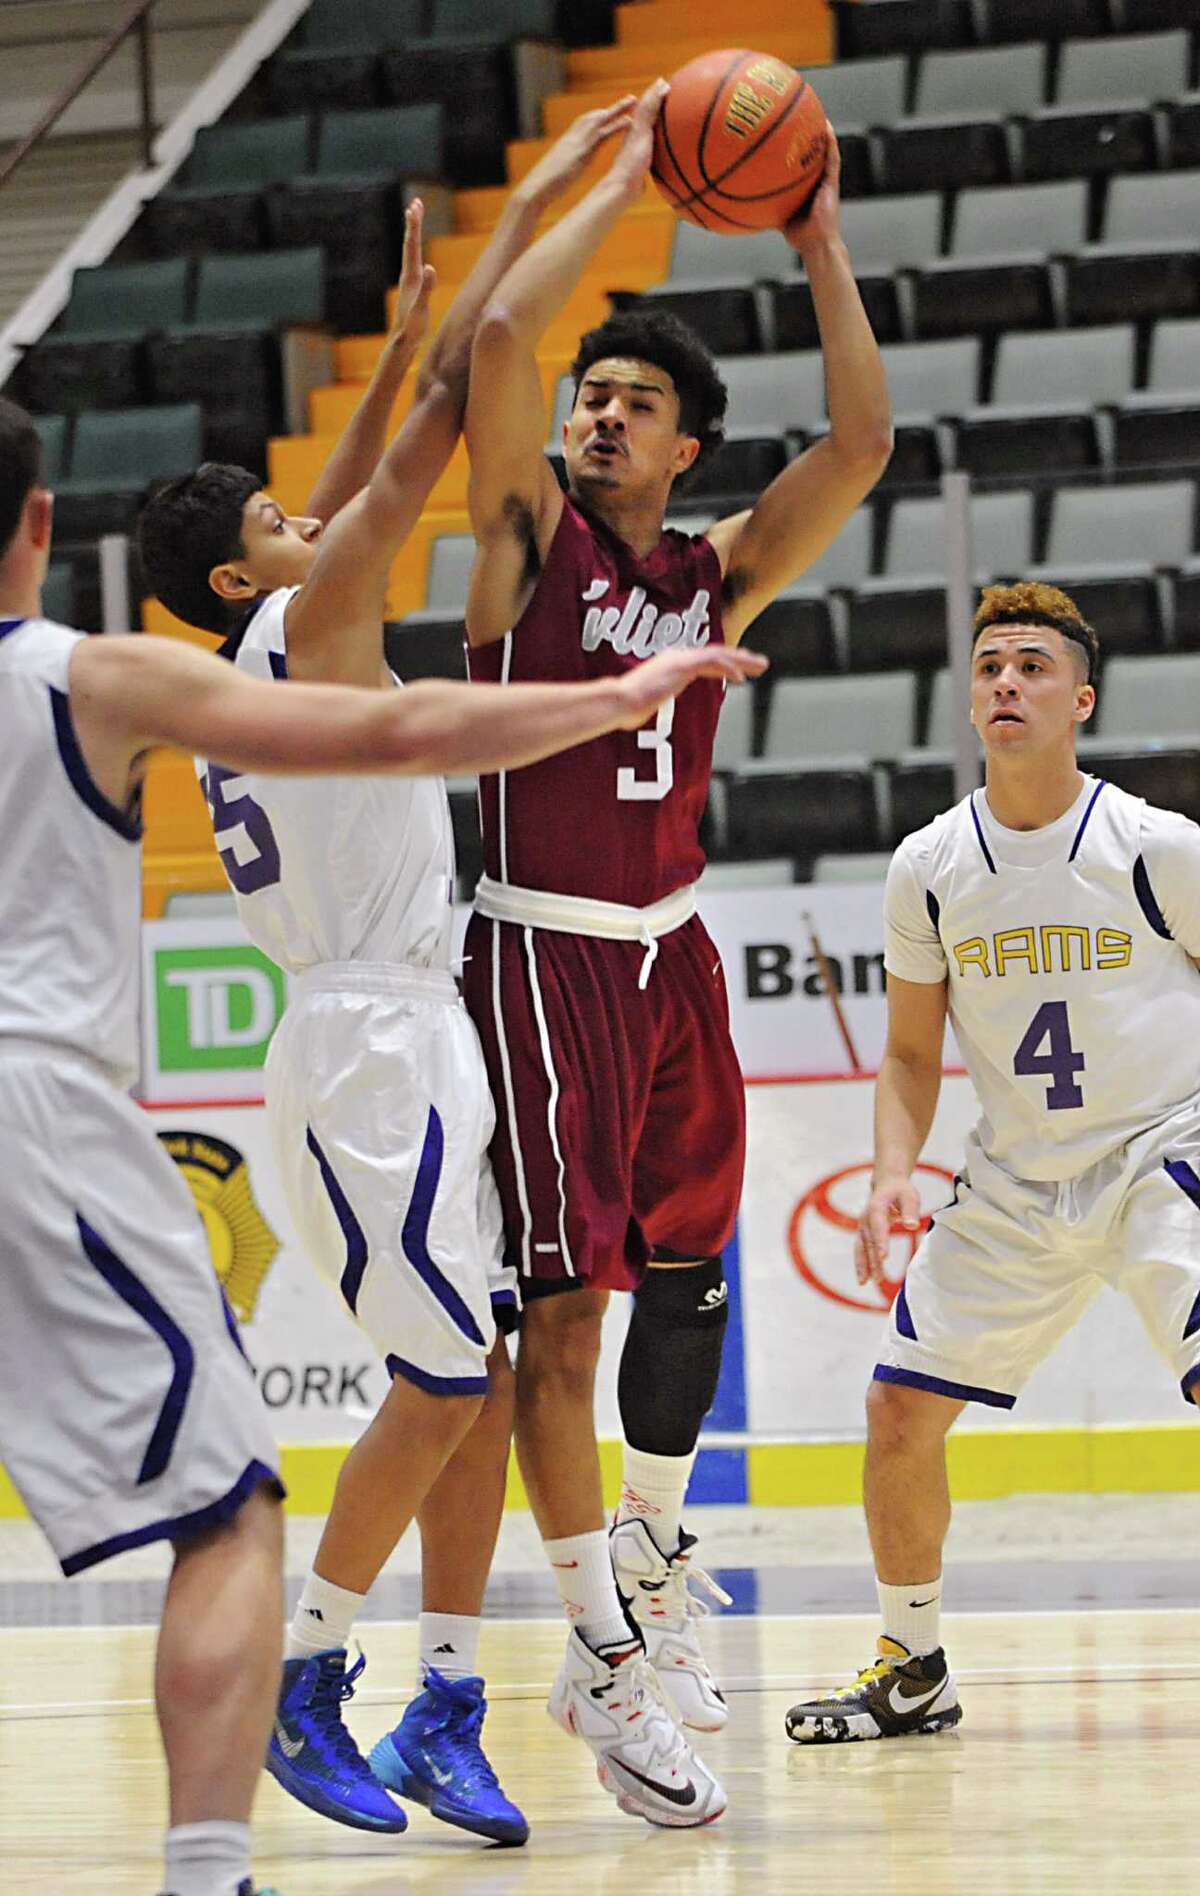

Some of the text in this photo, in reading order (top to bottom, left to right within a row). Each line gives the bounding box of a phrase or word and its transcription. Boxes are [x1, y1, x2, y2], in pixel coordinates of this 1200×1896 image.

[617, 694, 675, 800] 3
[953, 925, 1133, 978] RAMS
[165, 966, 277, 1049] TD
[1013, 1000, 1085, 1110] 4
[252, 1365, 370, 1407] ORK
